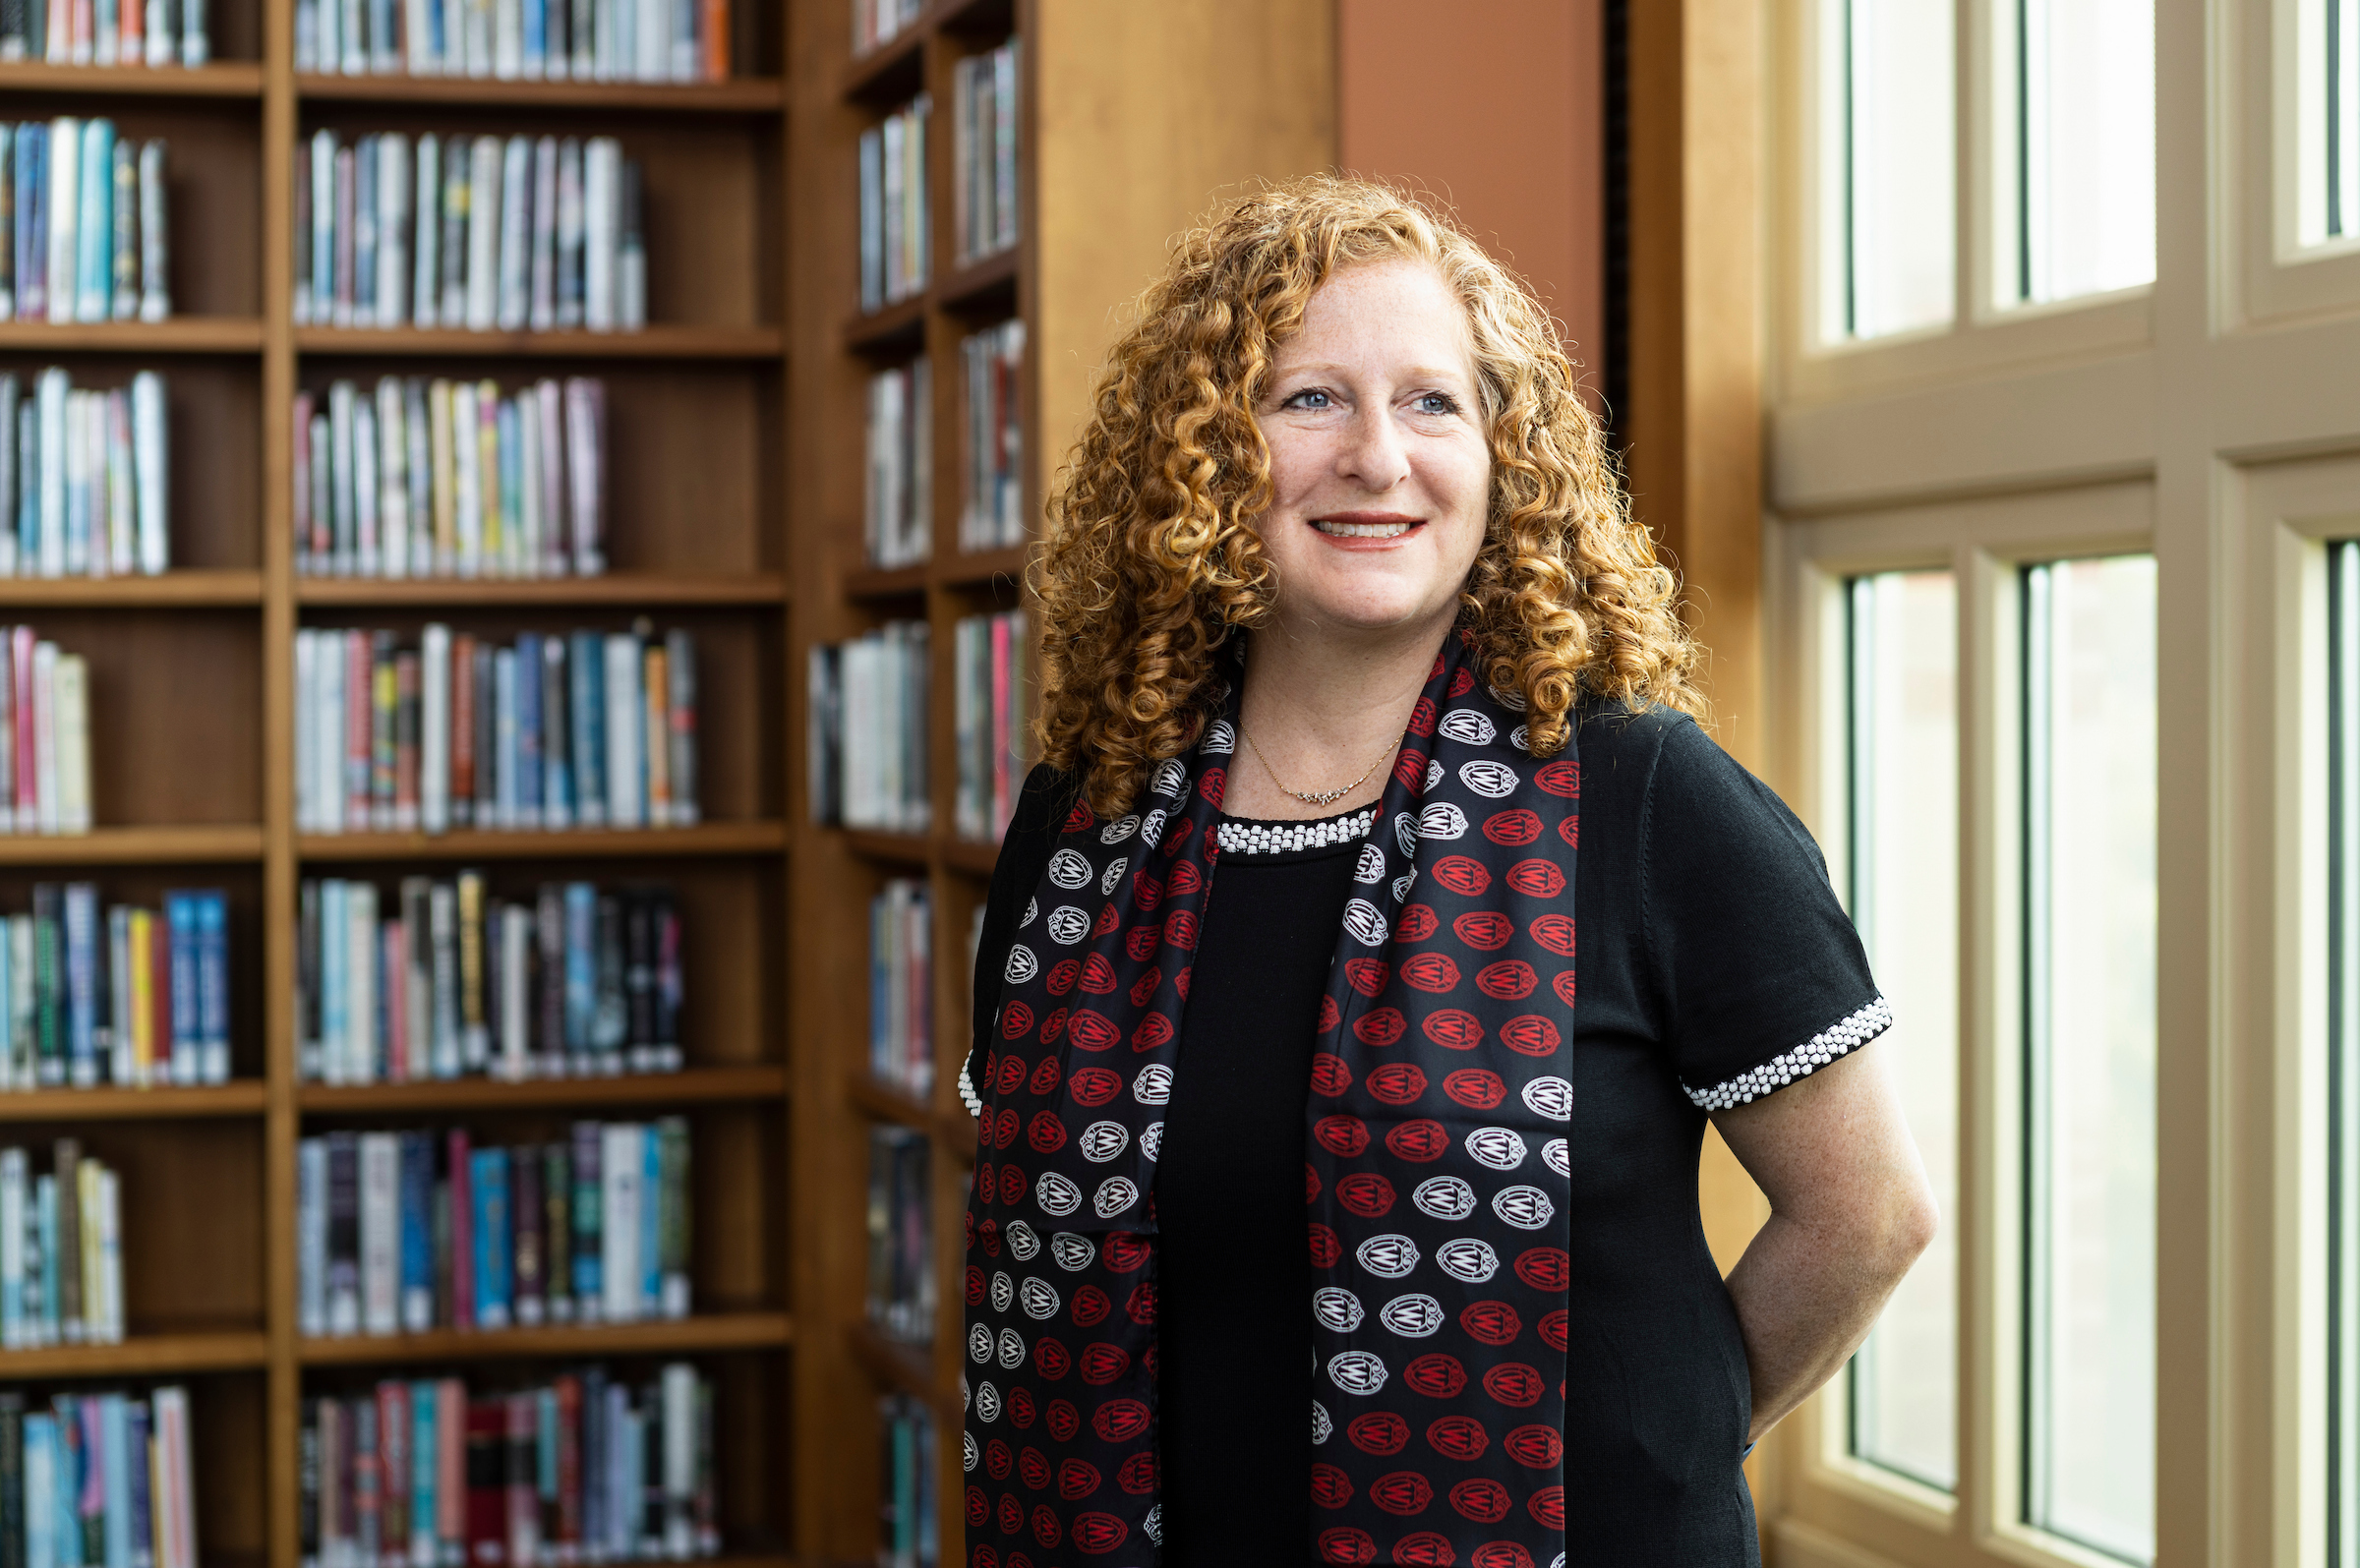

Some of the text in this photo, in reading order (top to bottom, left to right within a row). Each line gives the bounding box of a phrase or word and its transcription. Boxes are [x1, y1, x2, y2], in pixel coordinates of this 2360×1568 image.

[1207, 728, 1228, 745] W
[1449, 717, 1478, 738] W
[1472, 771, 1499, 789] W
[1548, 771, 1576, 789] W
[1115, 824, 1133, 836] W
[1422, 811, 1449, 831] W
[1497, 818, 1524, 837] W
[1061, 858, 1084, 879] W
[1445, 866, 1472, 886] W
[1524, 869, 1548, 888] W
[1062, 916, 1083, 934] W
[1176, 918, 1194, 940] W
[1348, 908, 1373, 935] W
[1467, 922, 1494, 941] W
[1543, 925, 1569, 945] W
[1012, 954, 1030, 973] W
[1084, 960, 1107, 983] W
[1414, 963, 1442, 983] W
[1058, 968, 1075, 986] W
[1489, 970, 1516, 990] W
[1008, 1011, 1026, 1029] W
[1366, 1016, 1387, 1035] W
[1437, 1019, 1463, 1039] W
[1081, 1019, 1108, 1043] W
[1514, 1025, 1541, 1046] W
[1003, 1065, 1020, 1084] W
[1041, 1065, 1057, 1084] W
[1148, 1074, 1172, 1095] W
[1380, 1074, 1406, 1093] W
[1087, 1076, 1112, 1096] W
[1457, 1079, 1485, 1099] W
[1534, 1087, 1563, 1108] W
[984, 1116, 992, 1134] W
[999, 1117, 1014, 1137] W
[1039, 1121, 1056, 1141] W
[1096, 1131, 1119, 1152] W
[1329, 1127, 1351, 1146] W
[1399, 1131, 1427, 1151] W
[1478, 1137, 1506, 1159] W
[985, 1175, 993, 1192] W
[1006, 1174, 1020, 1194] W
[1048, 1183, 1071, 1204] W
[1107, 1187, 1126, 1208] W
[1347, 1185, 1375, 1206] W
[1427, 1188, 1454, 1209] W
[1504, 1196, 1533, 1219] W
[1015, 1229, 1031, 1249] W
[1065, 1241, 1087, 1260] W
[1115, 1241, 1140, 1261] W
[1369, 1245, 1397, 1267] W
[1449, 1249, 1478, 1272] W
[1528, 1258, 1556, 1281] W
[969, 1277, 981, 1296] W
[997, 1282, 1009, 1301] W
[1031, 1287, 1049, 1307] W
[1081, 1295, 1099, 1314] W
[1321, 1299, 1345, 1321] W
[1394, 1305, 1422, 1327] W
[1473, 1310, 1501, 1334] W
[976, 1333, 989, 1353] W
[1004, 1338, 1019, 1358] W
[1046, 1348, 1062, 1368] W
[1092, 1354, 1117, 1373] W
[1339, 1362, 1368, 1385] W
[1418, 1365, 1446, 1387] W
[1496, 1373, 1524, 1397] W
[983, 1392, 995, 1411] W
[1016, 1398, 1032, 1418] W
[1057, 1409, 1072, 1429] W
[1111, 1411, 1139, 1431] W
[1361, 1423, 1389, 1444] W
[1440, 1426, 1468, 1450] W
[1518, 1434, 1546, 1458] W
[994, 1450, 1007, 1470] W
[1028, 1457, 1043, 1478] W
[1066, 1468, 1088, 1488] W
[1384, 1481, 1412, 1505] W
[1462, 1488, 1490, 1511] W
[971, 1495, 983, 1516] W
[1005, 1503, 1018, 1523] W
[1041, 1516, 1055, 1537] W
[1088, 1523, 1115, 1543] W
[1329, 1538, 1357, 1560] W
[1405, 1542, 1434, 1565] W
